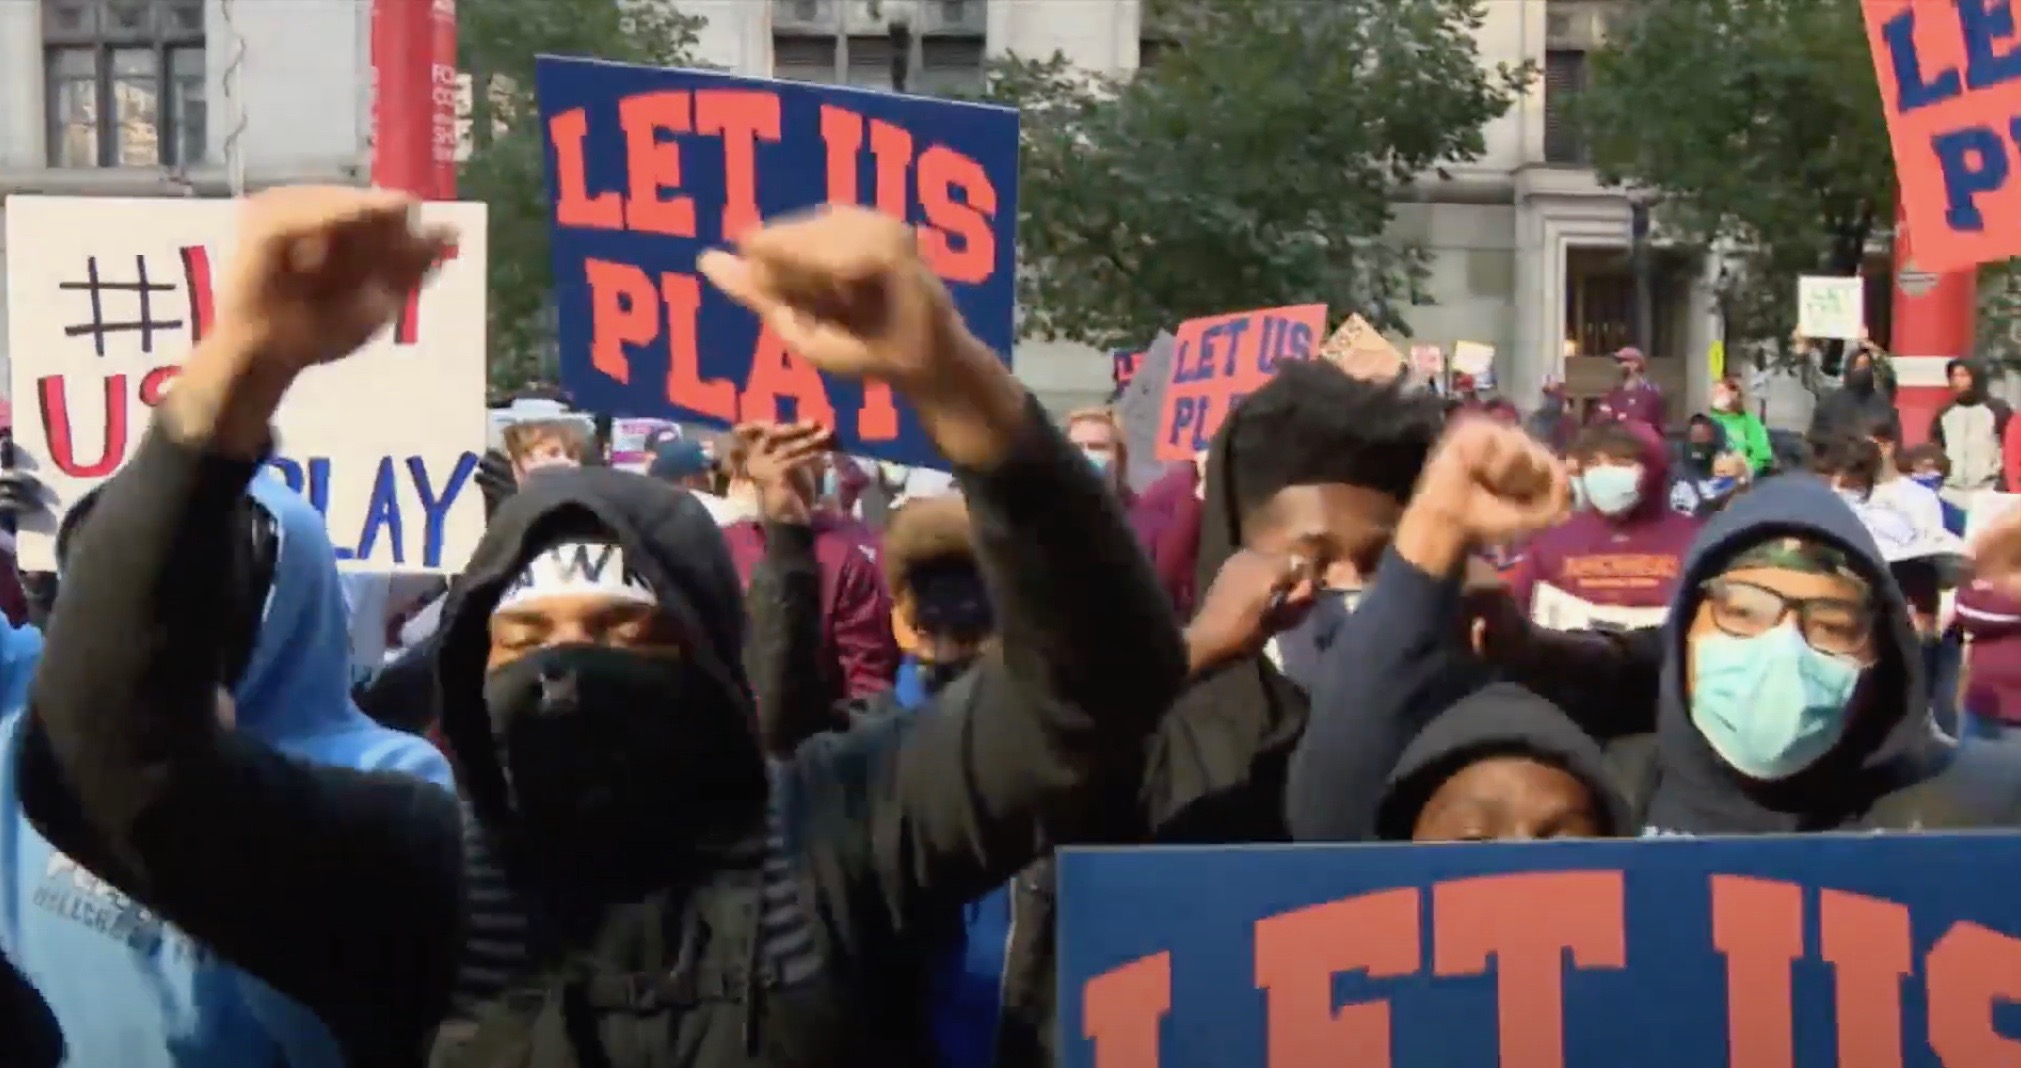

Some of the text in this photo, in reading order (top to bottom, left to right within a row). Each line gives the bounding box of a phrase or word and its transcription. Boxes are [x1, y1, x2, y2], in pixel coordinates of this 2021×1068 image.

[549, 88, 781, 244] LET
[820, 104, 997, 283] US
[1930, 115, 2021, 231] P
[1172, 318, 1250, 384] LET
[1168, 393, 1245, 451] PL
[266, 451, 478, 568] LAY
